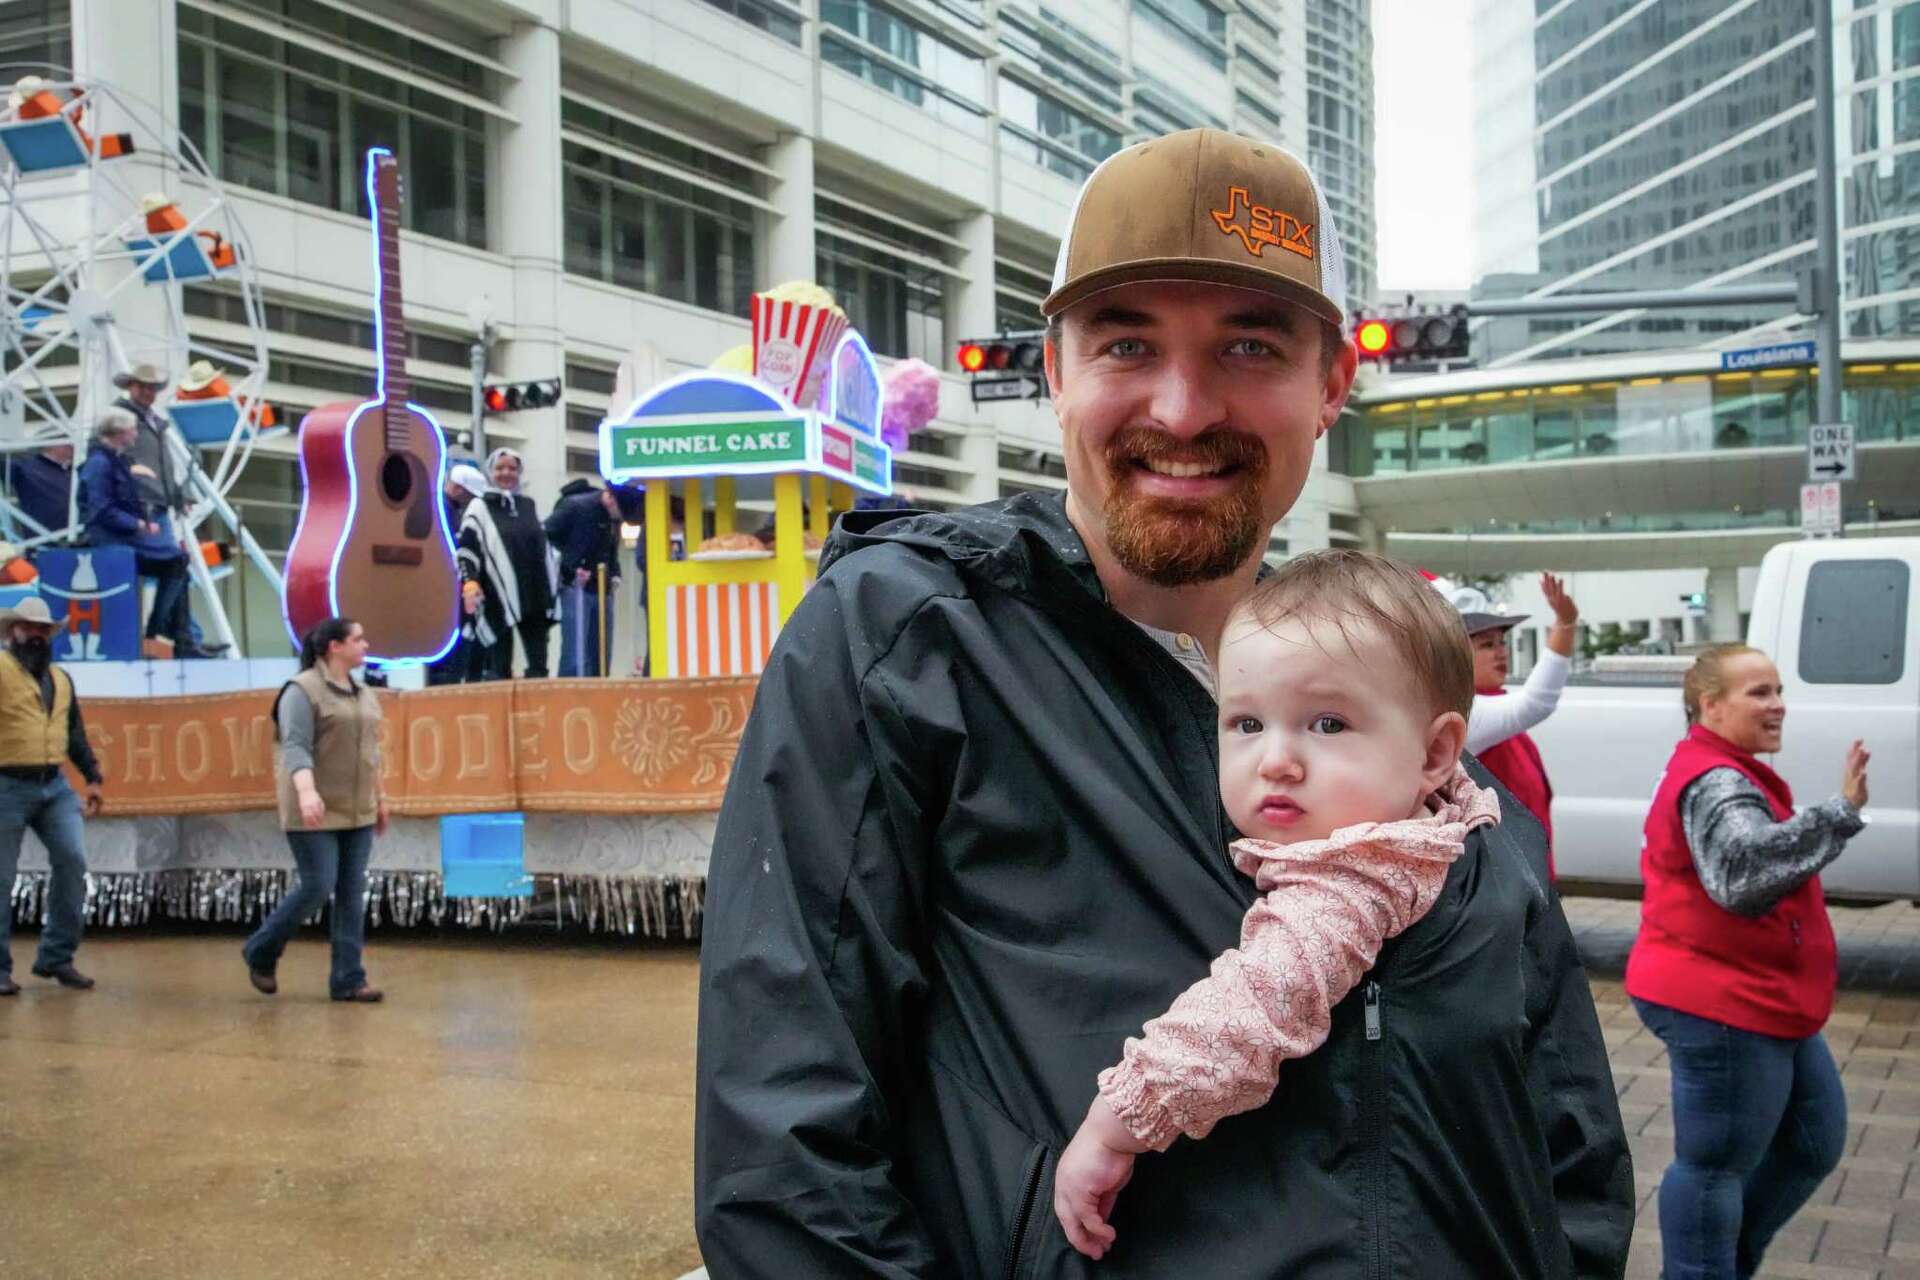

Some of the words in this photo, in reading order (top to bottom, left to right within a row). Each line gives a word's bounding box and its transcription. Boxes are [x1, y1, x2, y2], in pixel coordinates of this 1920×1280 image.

[1250, 205, 1313, 247] STX
[1727, 346, 1809, 369] Louisiana
[625, 435, 721, 456] FUNNEL
[726, 431, 791, 452] CAKE
[1814, 428, 1849, 441] ONE
[1814, 444, 1849, 457] WAY
